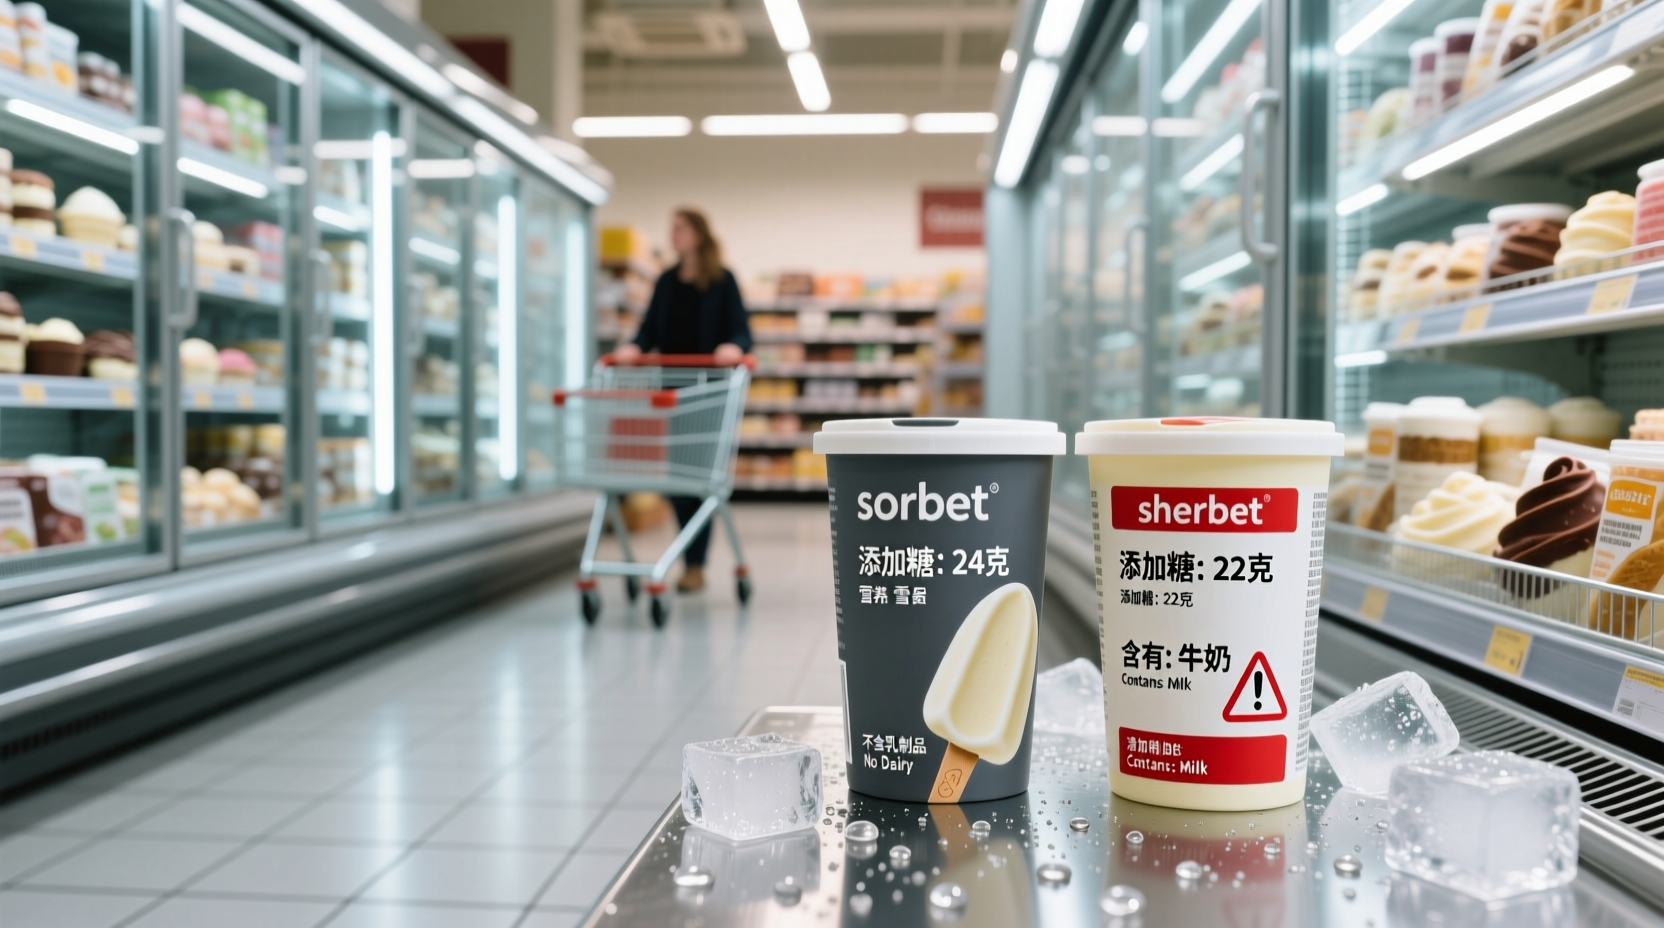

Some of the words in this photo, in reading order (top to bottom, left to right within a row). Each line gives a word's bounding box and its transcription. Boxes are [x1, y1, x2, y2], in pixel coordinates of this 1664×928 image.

[1178, 643, 1231, 673] 牛奶
[863, 753, 878, 769] No
[881, 754, 914, 776] Dairy
[1179, 759, 1208, 776] Milk
